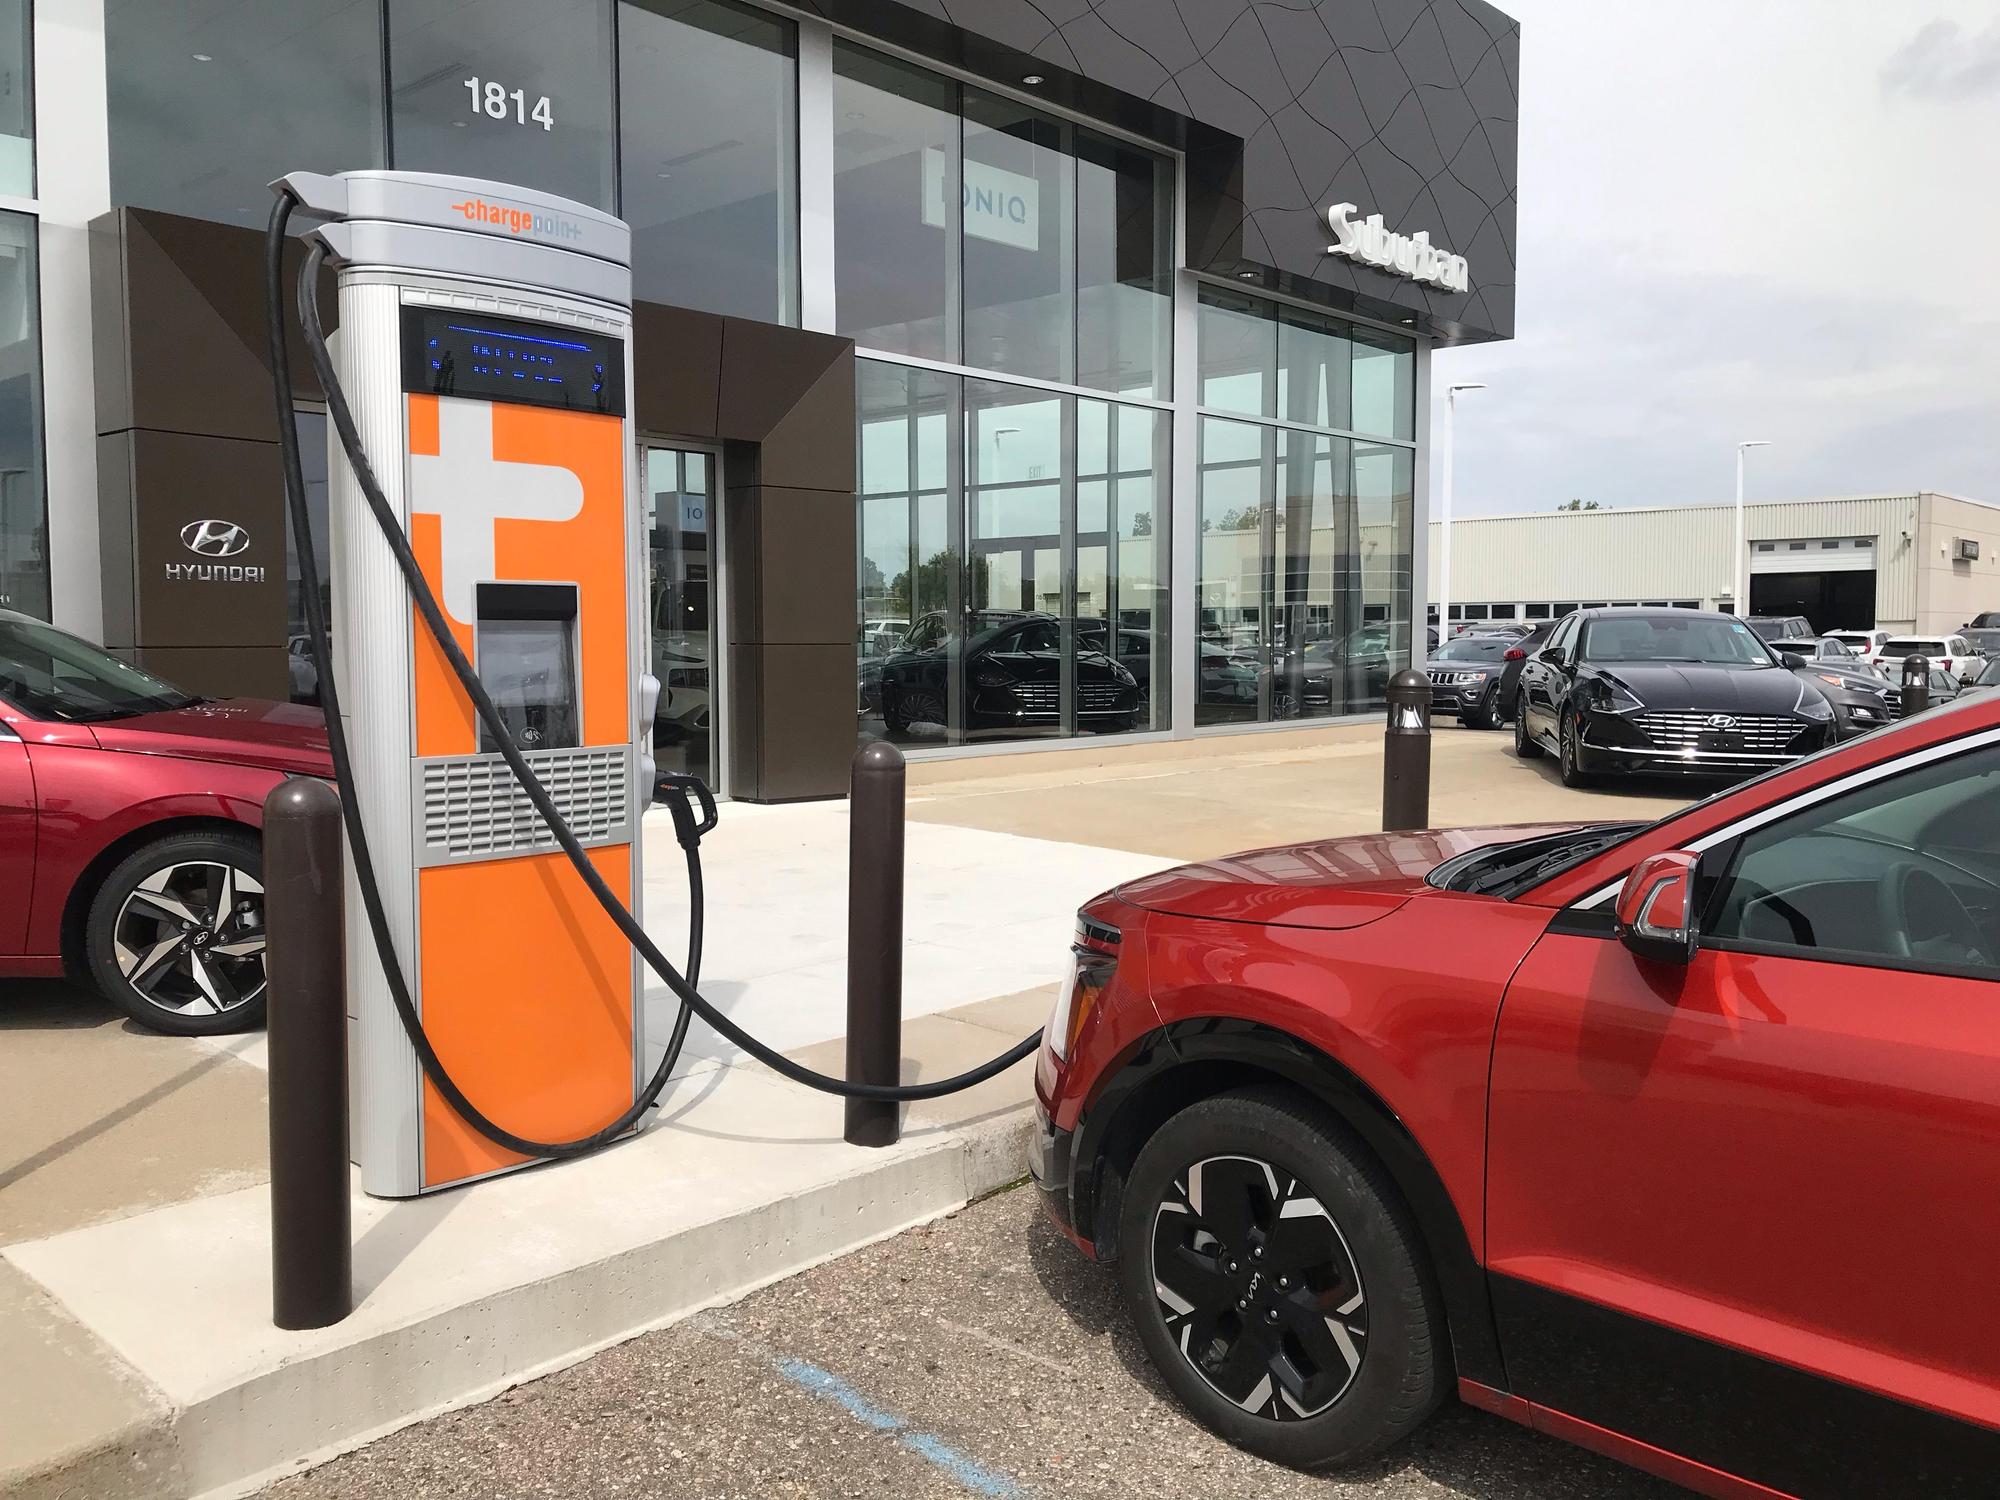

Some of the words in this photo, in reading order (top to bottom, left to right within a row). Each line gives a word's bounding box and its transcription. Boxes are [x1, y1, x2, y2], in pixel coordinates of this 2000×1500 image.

[464, 76, 554, 131] 1814
[1328, 202, 1469, 293] Suburban
[165, 563, 265, 583] HYUNDAI
